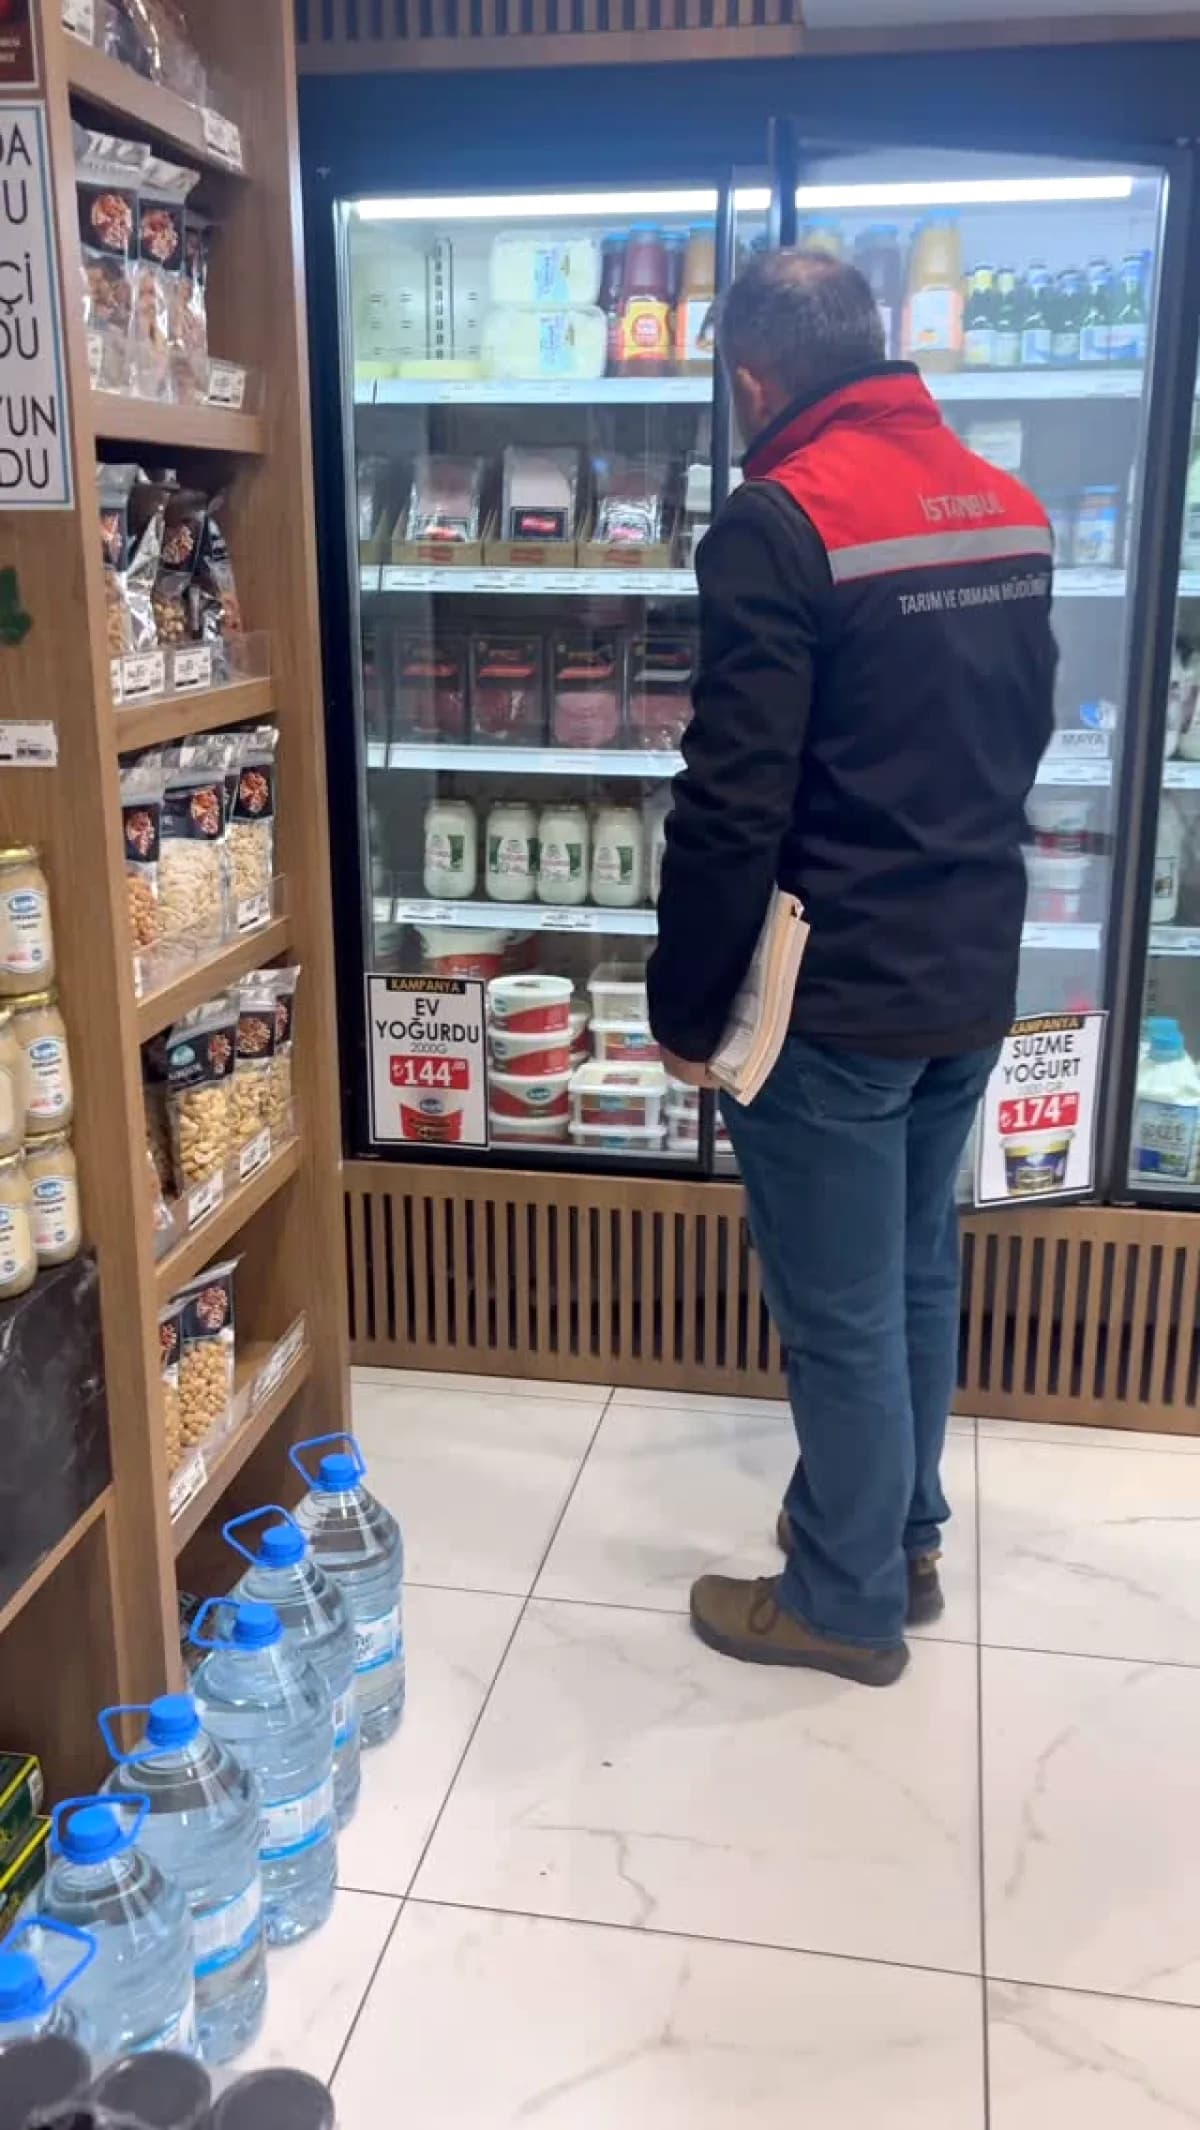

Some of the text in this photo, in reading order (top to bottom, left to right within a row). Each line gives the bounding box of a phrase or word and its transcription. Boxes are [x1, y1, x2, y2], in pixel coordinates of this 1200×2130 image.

[0, 122, 32, 166] A
[0, 395, 57, 436] UN
[0, 448, 49, 489] DU
[898, 591, 942, 615] TARIM
[942, 588, 958, 609] VE
[958, 584, 1001, 608] ORMAN
[392, 978, 461, 993] KAMPANYA
[415, 998, 439, 1017] EV
[376, 1018, 480, 1043] YOĞURDU
[1003, 1058, 1081, 1085] YOĞURT
